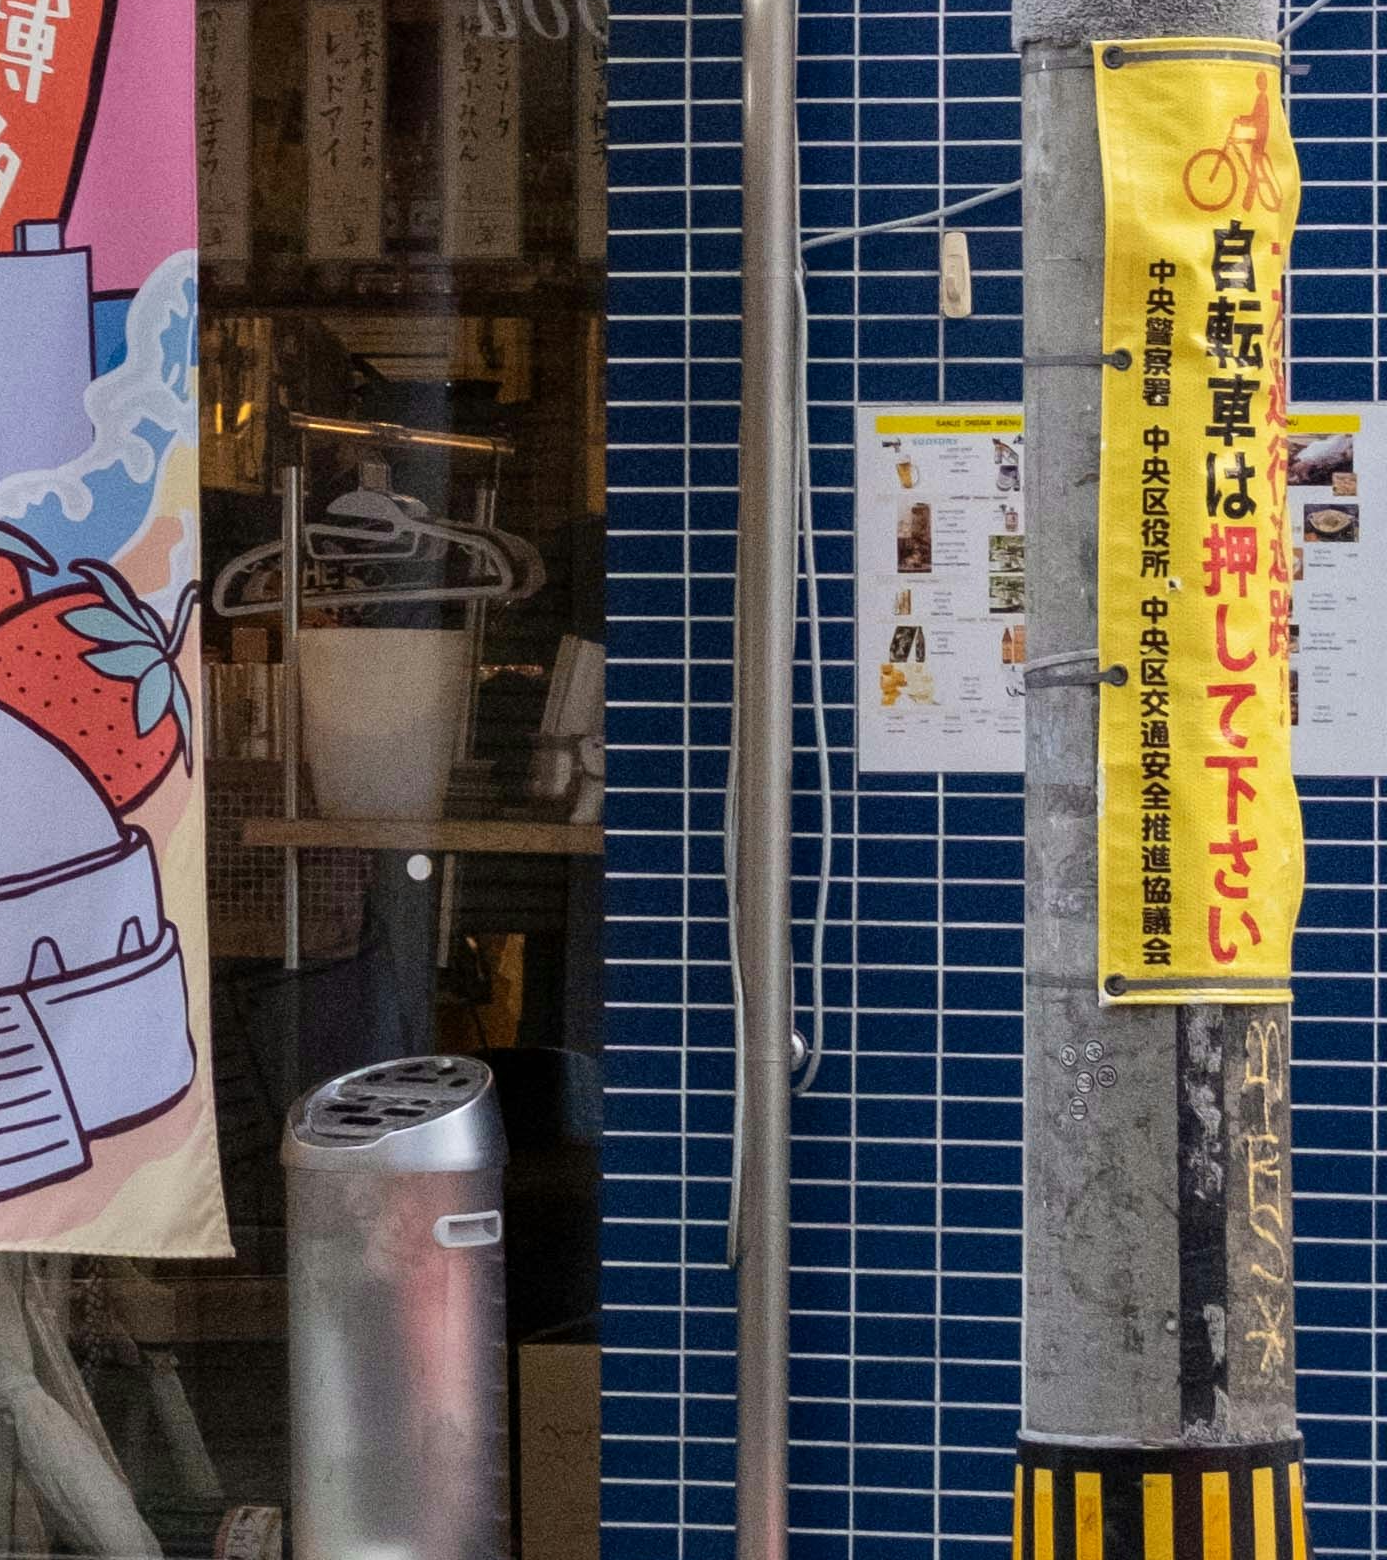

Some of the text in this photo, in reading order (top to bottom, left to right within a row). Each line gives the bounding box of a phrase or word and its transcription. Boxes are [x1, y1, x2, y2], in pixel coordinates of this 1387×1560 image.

[319, 32, 351, 168] レッドアイ
[1139, 258, 1177, 967] 中央警察署 中央区役所 中央区交通安全推進協議会
[1202, 219, 1263, 964] 自転車は押して下さい
